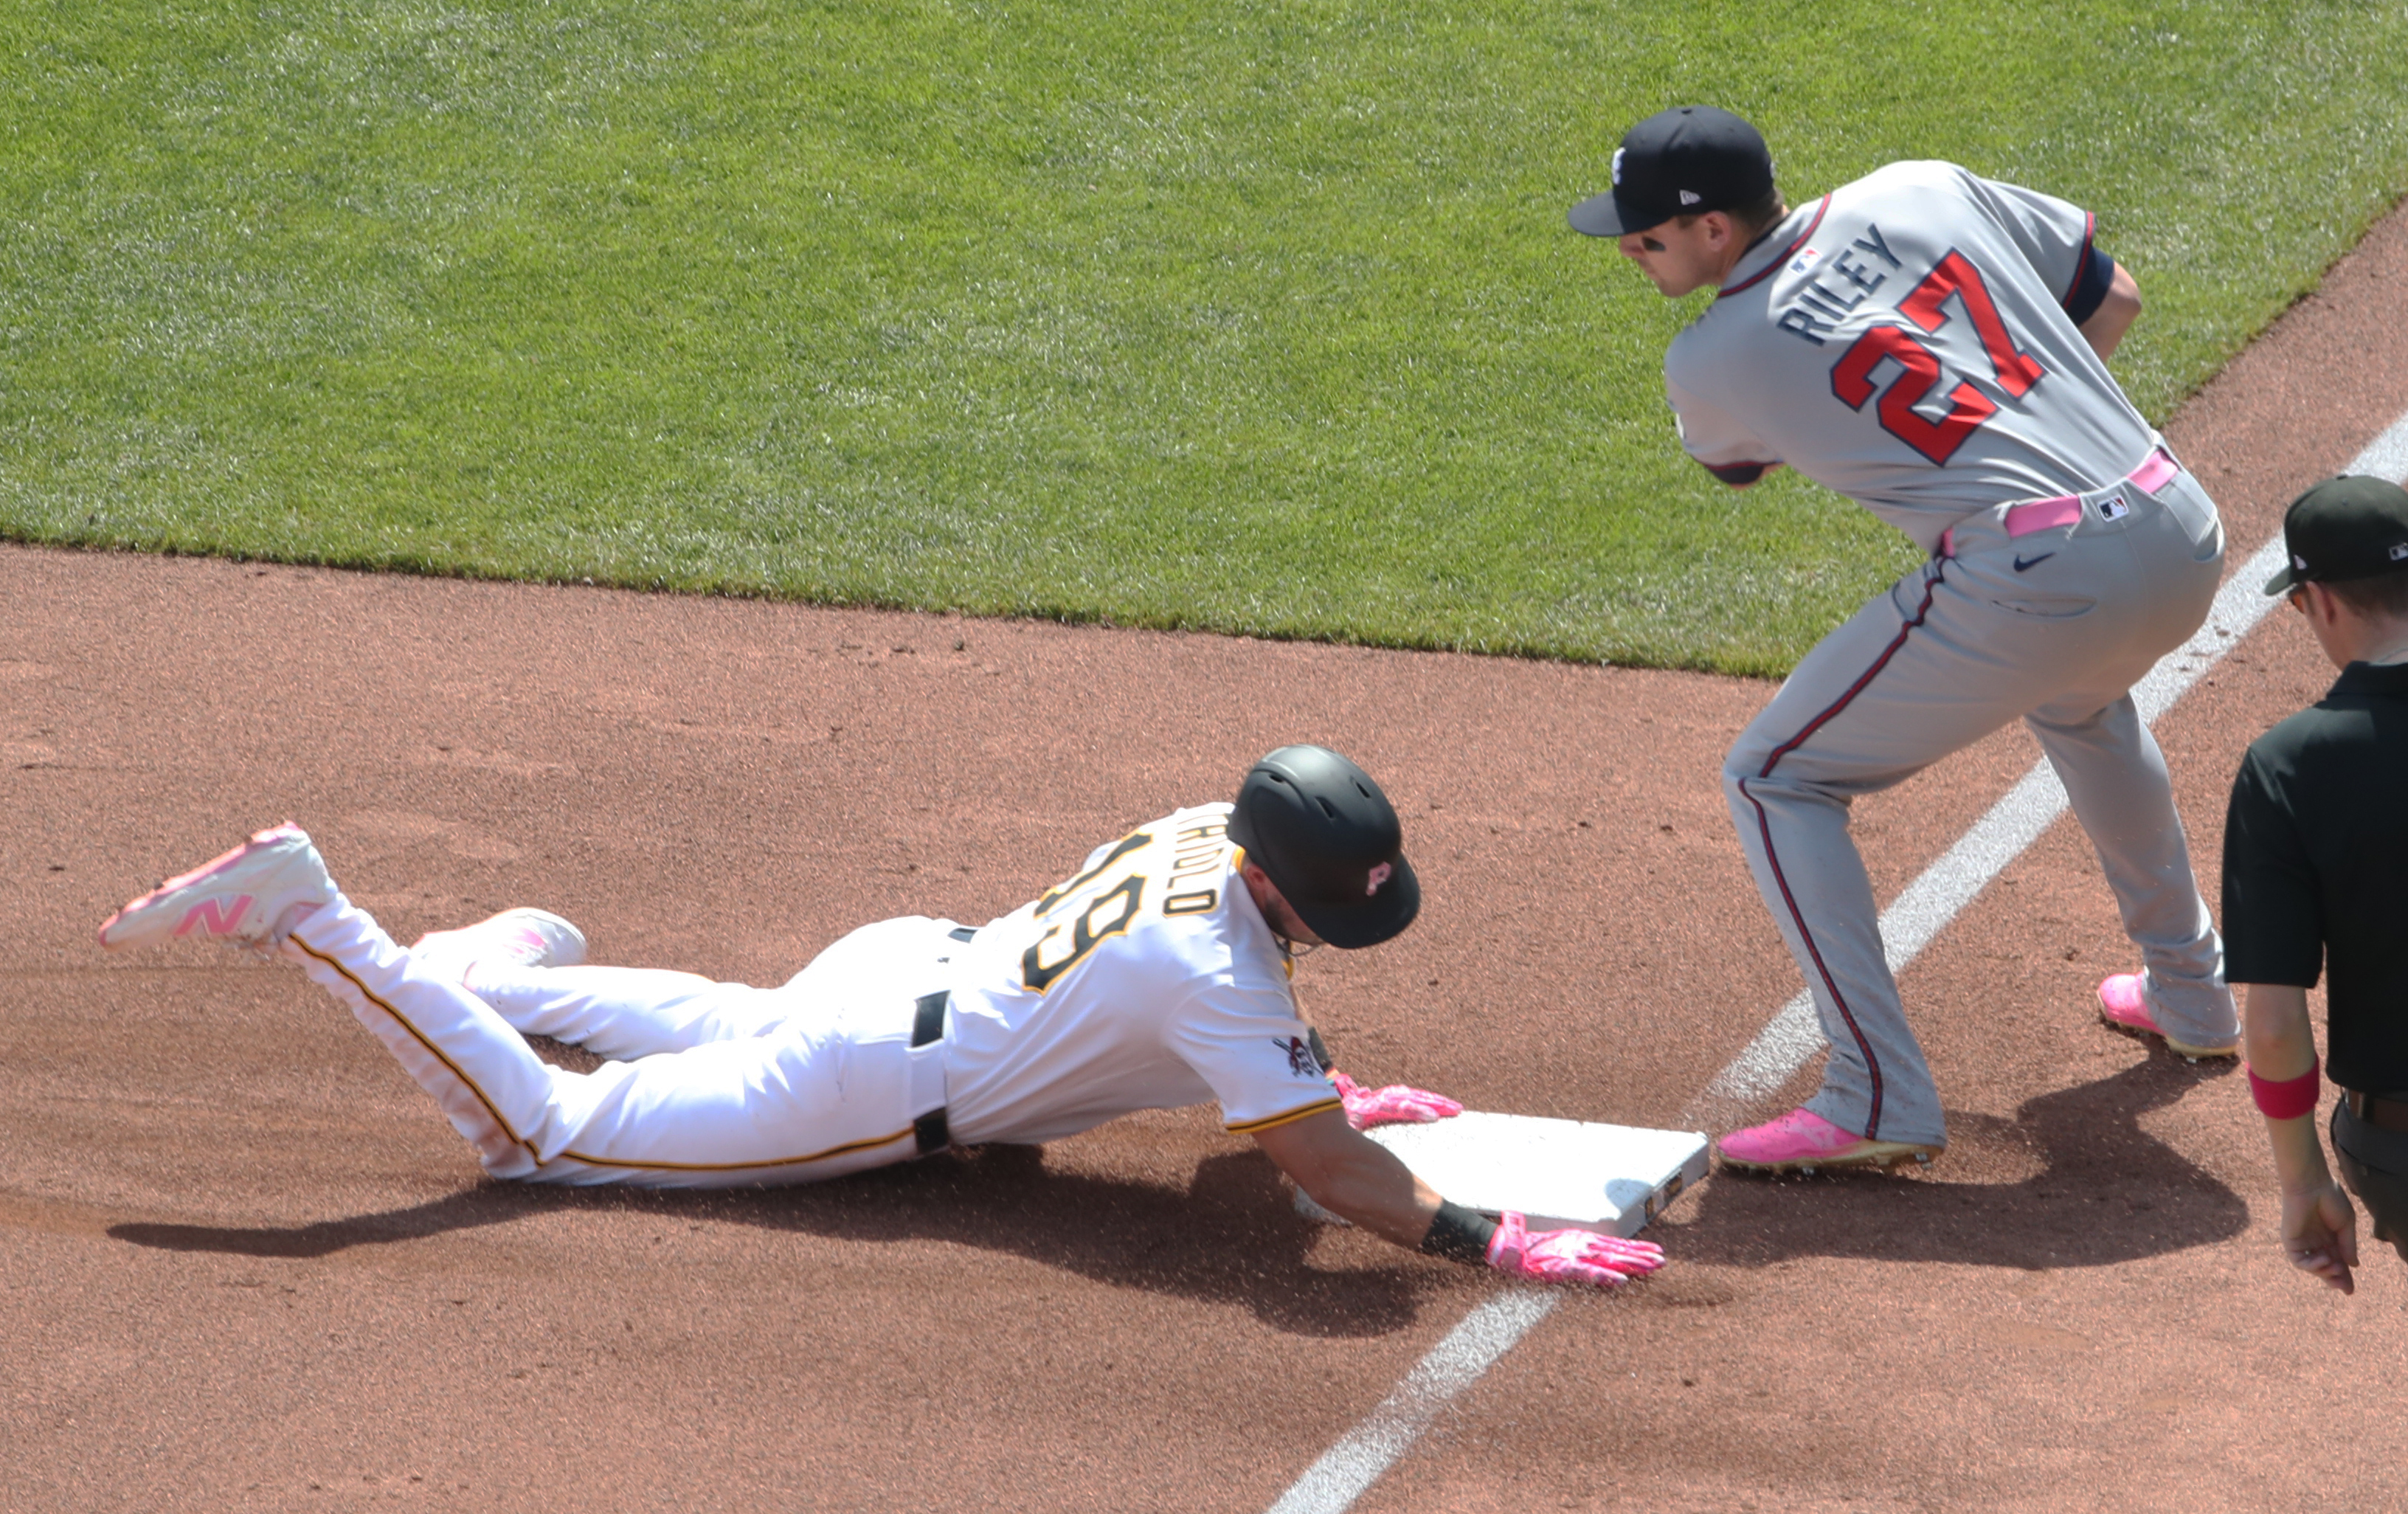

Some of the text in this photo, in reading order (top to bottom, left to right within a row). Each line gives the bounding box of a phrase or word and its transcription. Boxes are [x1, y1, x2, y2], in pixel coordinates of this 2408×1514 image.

[1776, 224, 1903, 348] RILEY
[1829, 246, 2046, 469] 27
[1021, 833, 1154, 998] 19
[1366, 860, 1391, 896] P
